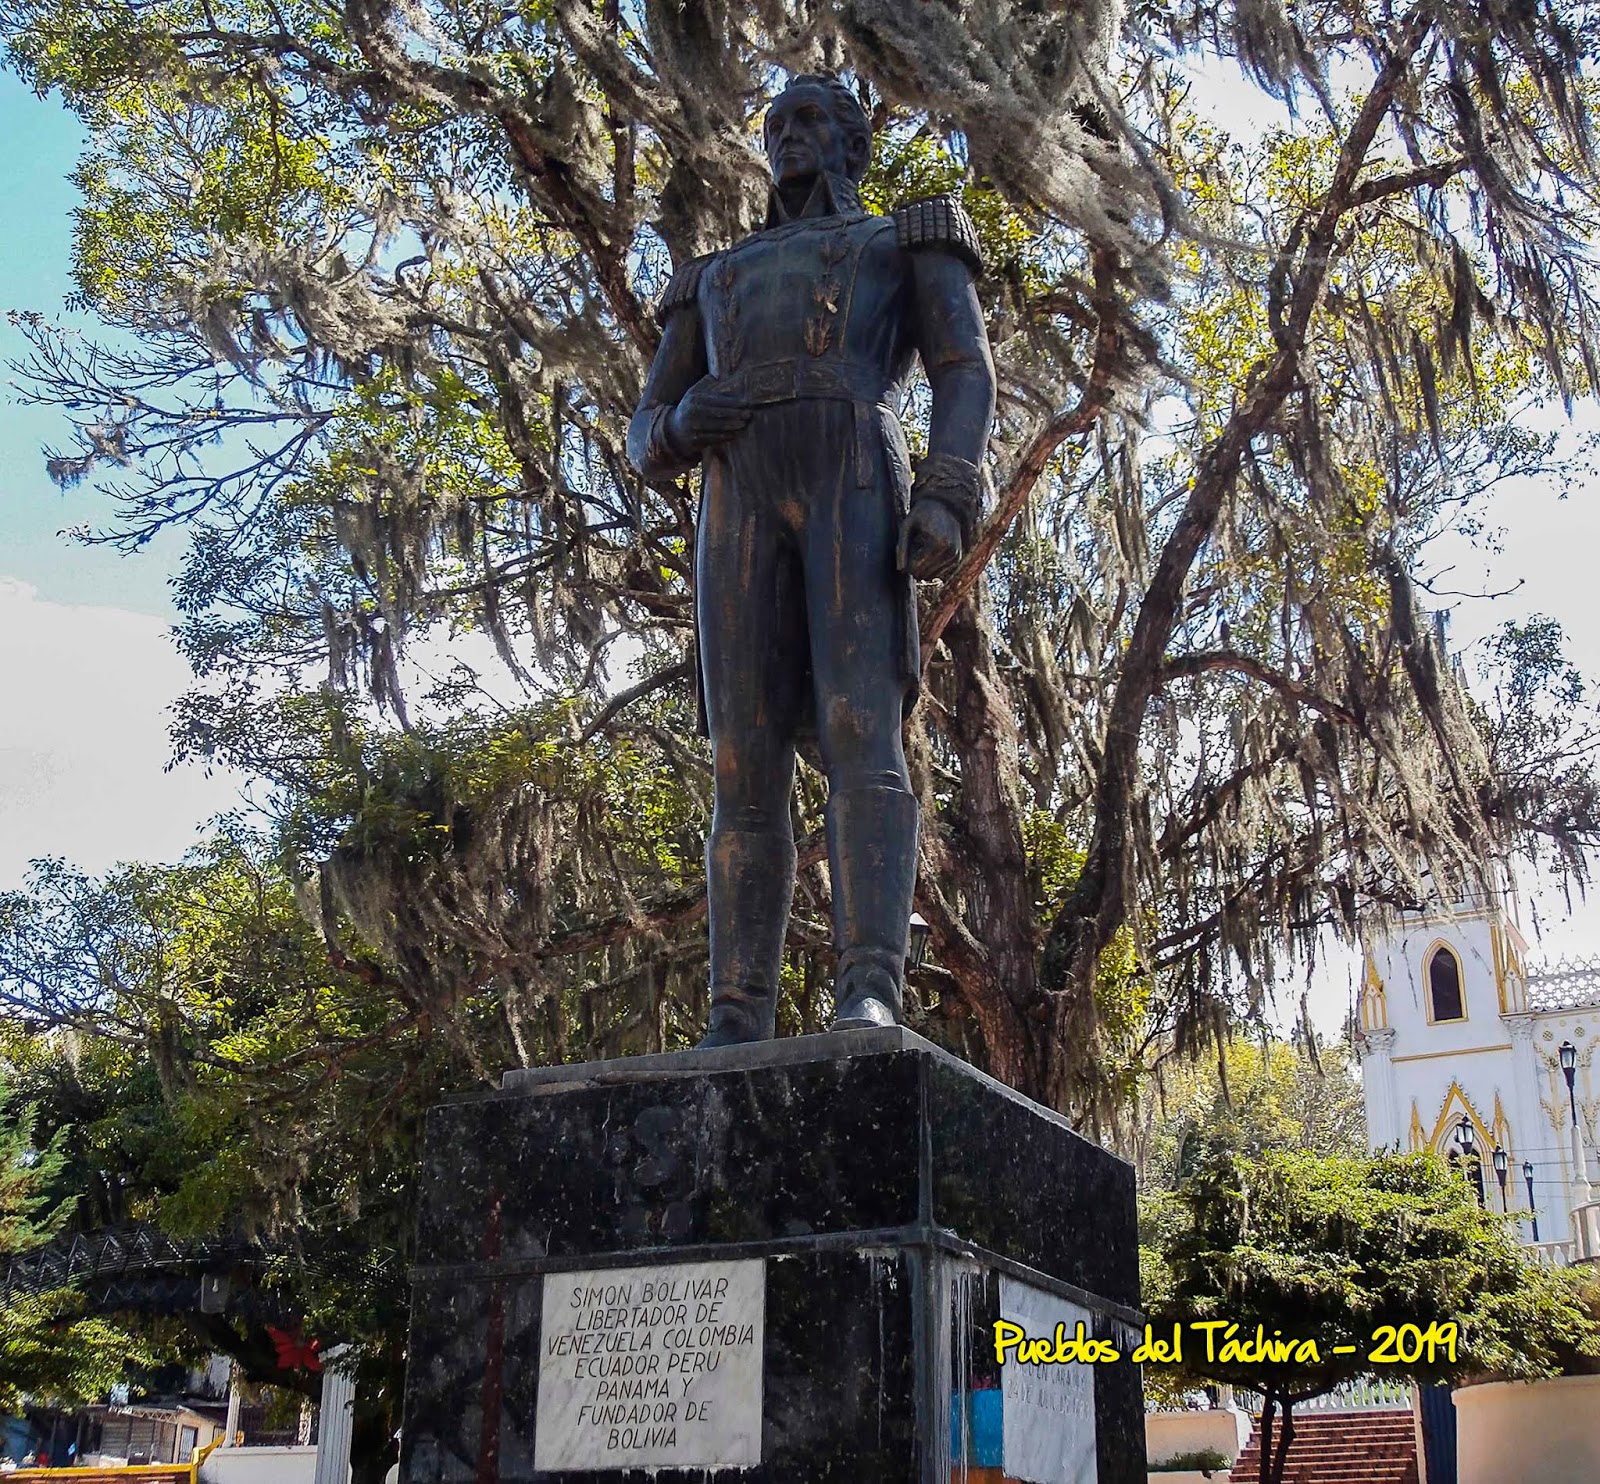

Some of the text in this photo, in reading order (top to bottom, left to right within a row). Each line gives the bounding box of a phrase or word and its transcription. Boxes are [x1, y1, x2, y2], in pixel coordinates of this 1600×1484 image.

[570, 1278, 729, 1308] SIMON BOLIVAR
[575, 1301, 723, 1331] LIBERTADOR DE
[548, 1325, 754, 1355] VENEZUELA COLOMBIA
[575, 1351, 721, 1379] ECUADOR PERU
[596, 1377, 693, 1401] PANAMA Y
[577, 1401, 713, 1426] FUNDADOR DE
[607, 1428, 677, 1450] BOLIVIA
